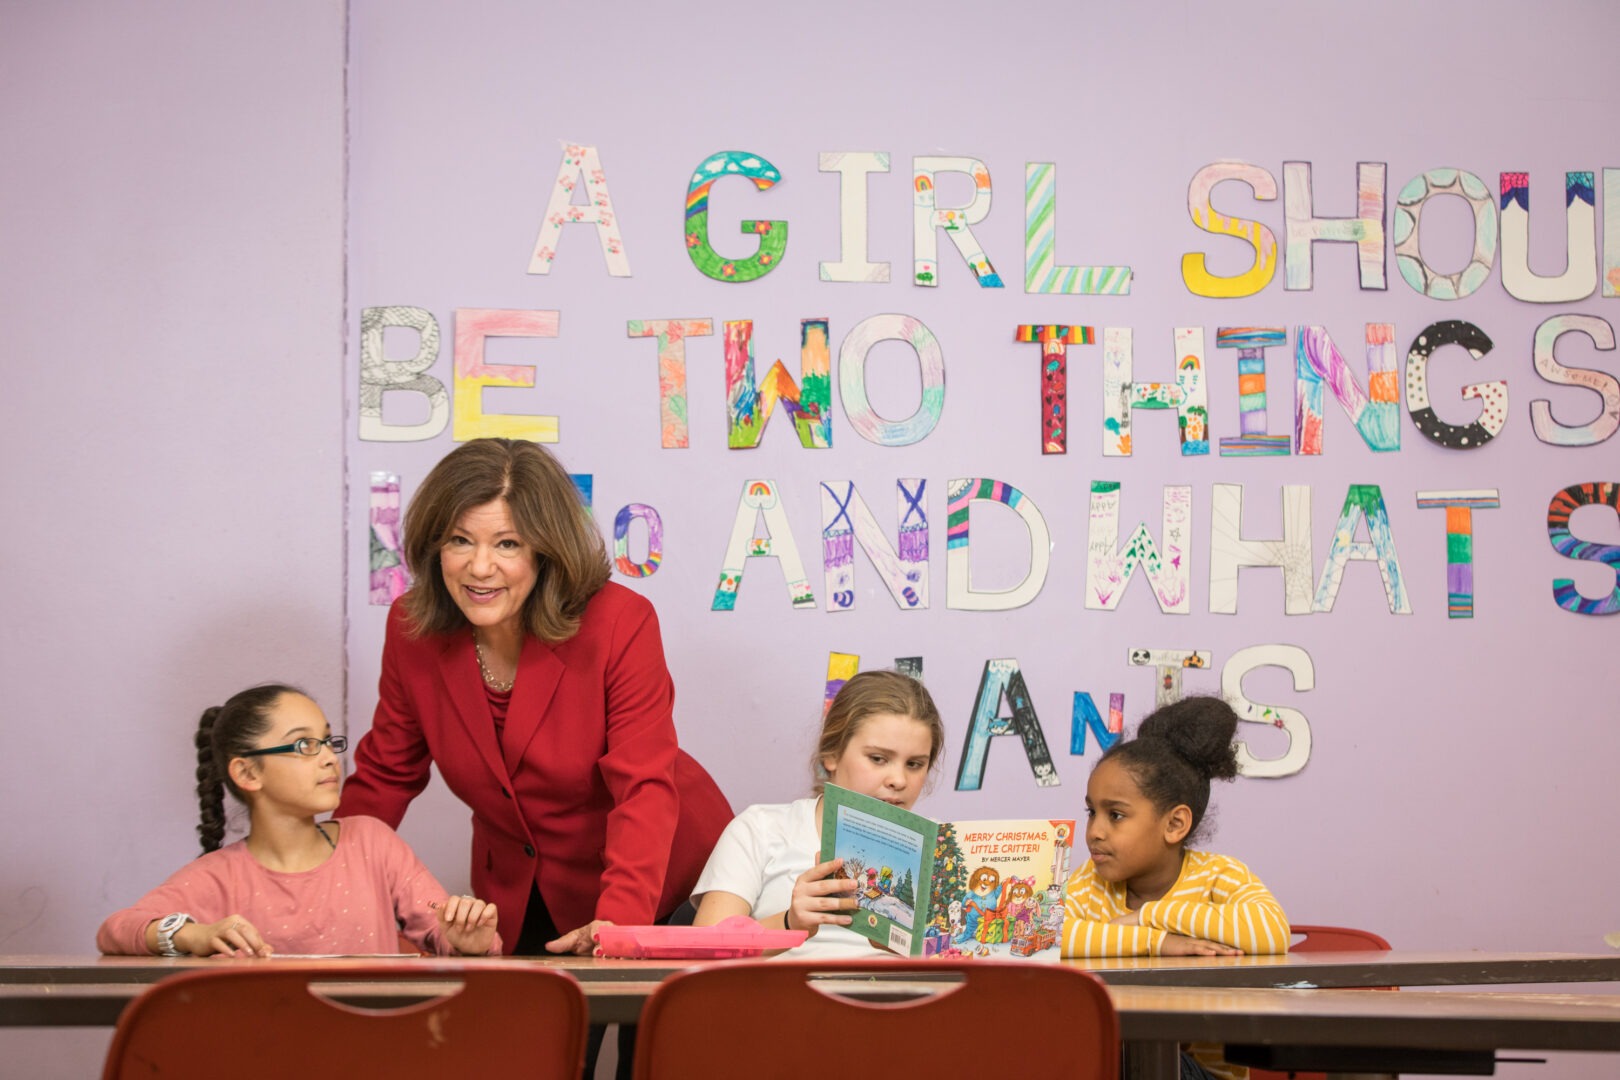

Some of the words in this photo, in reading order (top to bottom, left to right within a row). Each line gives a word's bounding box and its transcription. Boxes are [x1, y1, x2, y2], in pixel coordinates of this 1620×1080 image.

[526, 141, 632, 278] A
[684, 150, 1133, 296] GIRL
[1181, 159, 1620, 304] SHOU
[358, 305, 560, 443] BE
[627, 313, 945, 450] TWO
[1014, 313, 1620, 457] THINGS
[710, 477, 1050, 613] AND
[1084, 480, 1499, 619] WHAT
[824, 643, 1315, 792] ANTS
[964, 833, 994, 842] MERRY
[995, 831, 1049, 841] CHRISTMAS,
[970, 844, 999, 855] LITTLE
[1001, 843, 1040, 853] CRITTER!
